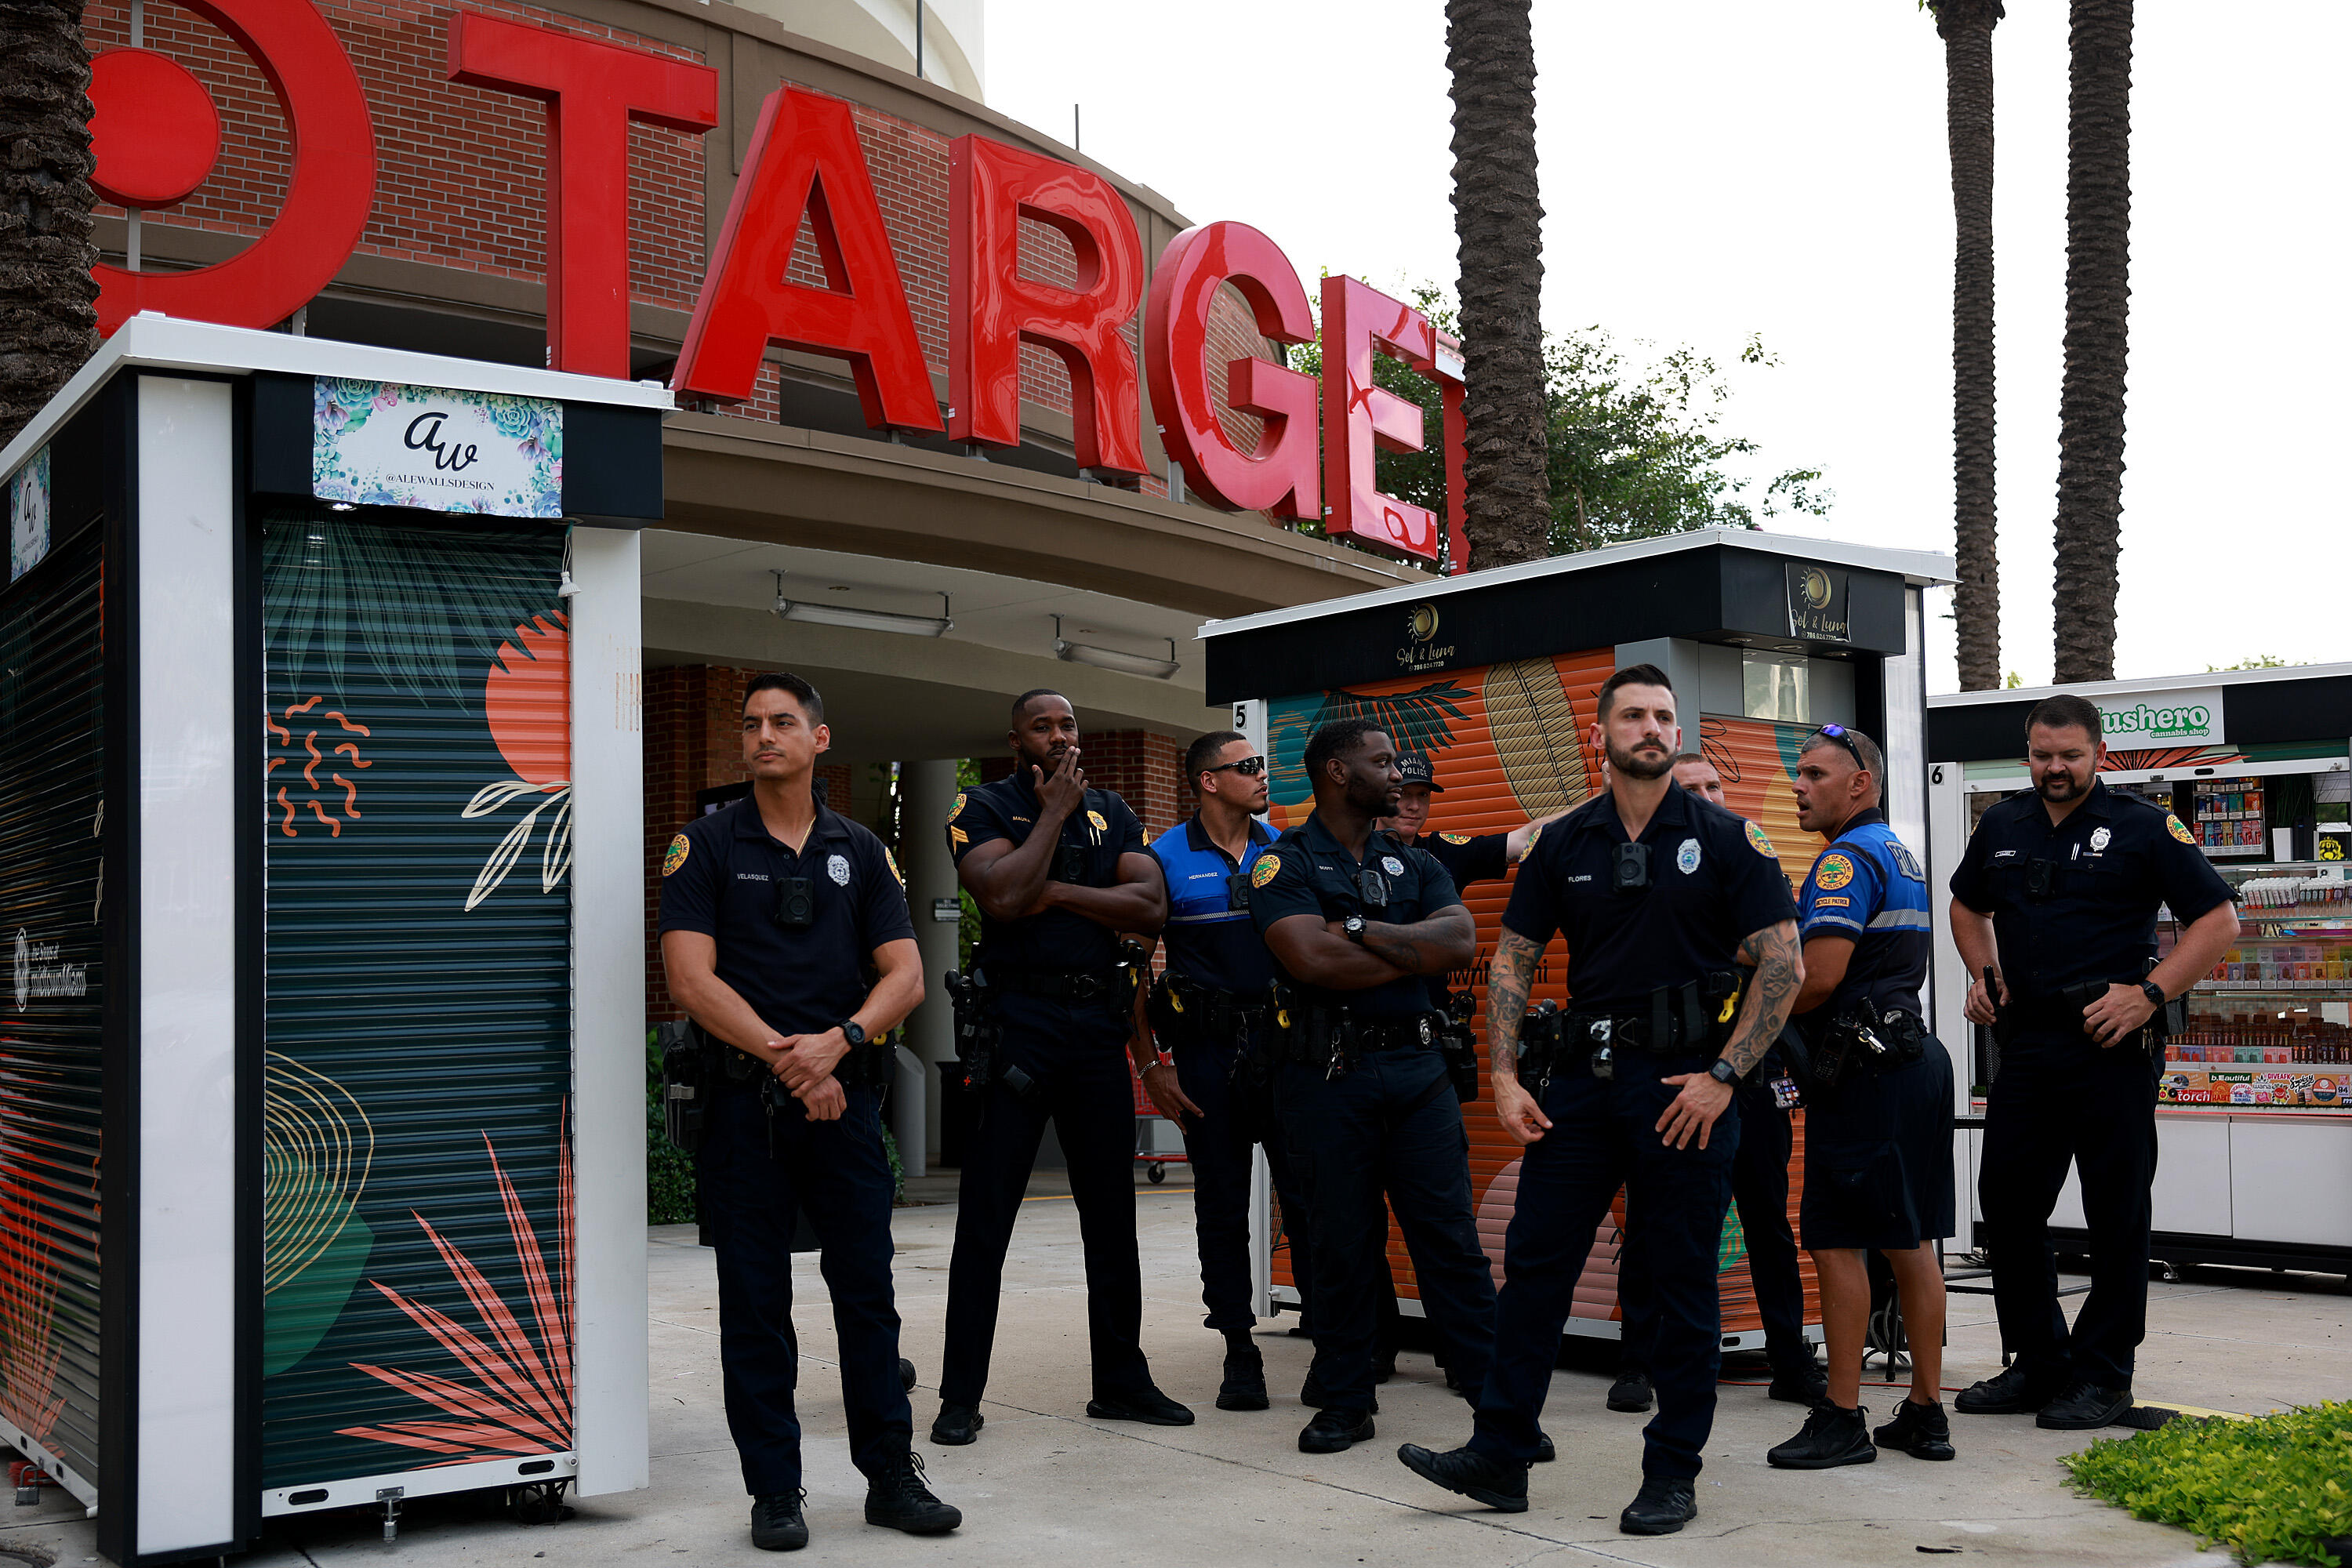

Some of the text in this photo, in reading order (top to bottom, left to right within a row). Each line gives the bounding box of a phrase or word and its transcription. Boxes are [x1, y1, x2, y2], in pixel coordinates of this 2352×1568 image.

[386, 473, 495, 491] @ALEWALLSDESIGN
[1813, 616, 1817, 629] &
[1821, 614, 1846, 633] Luna
[1396, 643, 1455, 666] Sol & Luna
[1236, 705, 1246, 728] 5
[2151, 729, 2187, 738] cannabis
[1400, 757, 1425, 769] MIAMI
[1402, 767, 1428, 777] POLICE
[1931, 765, 1943, 785] 6
[1820, 857, 1831, 867] CITY
[1839, 857, 1852, 873] MIAMI
[1189, 872, 1218, 880] HERNANDEZ
[1822, 880, 1843, 889] POLICE
[2178, 1091, 2210, 1102] torch
